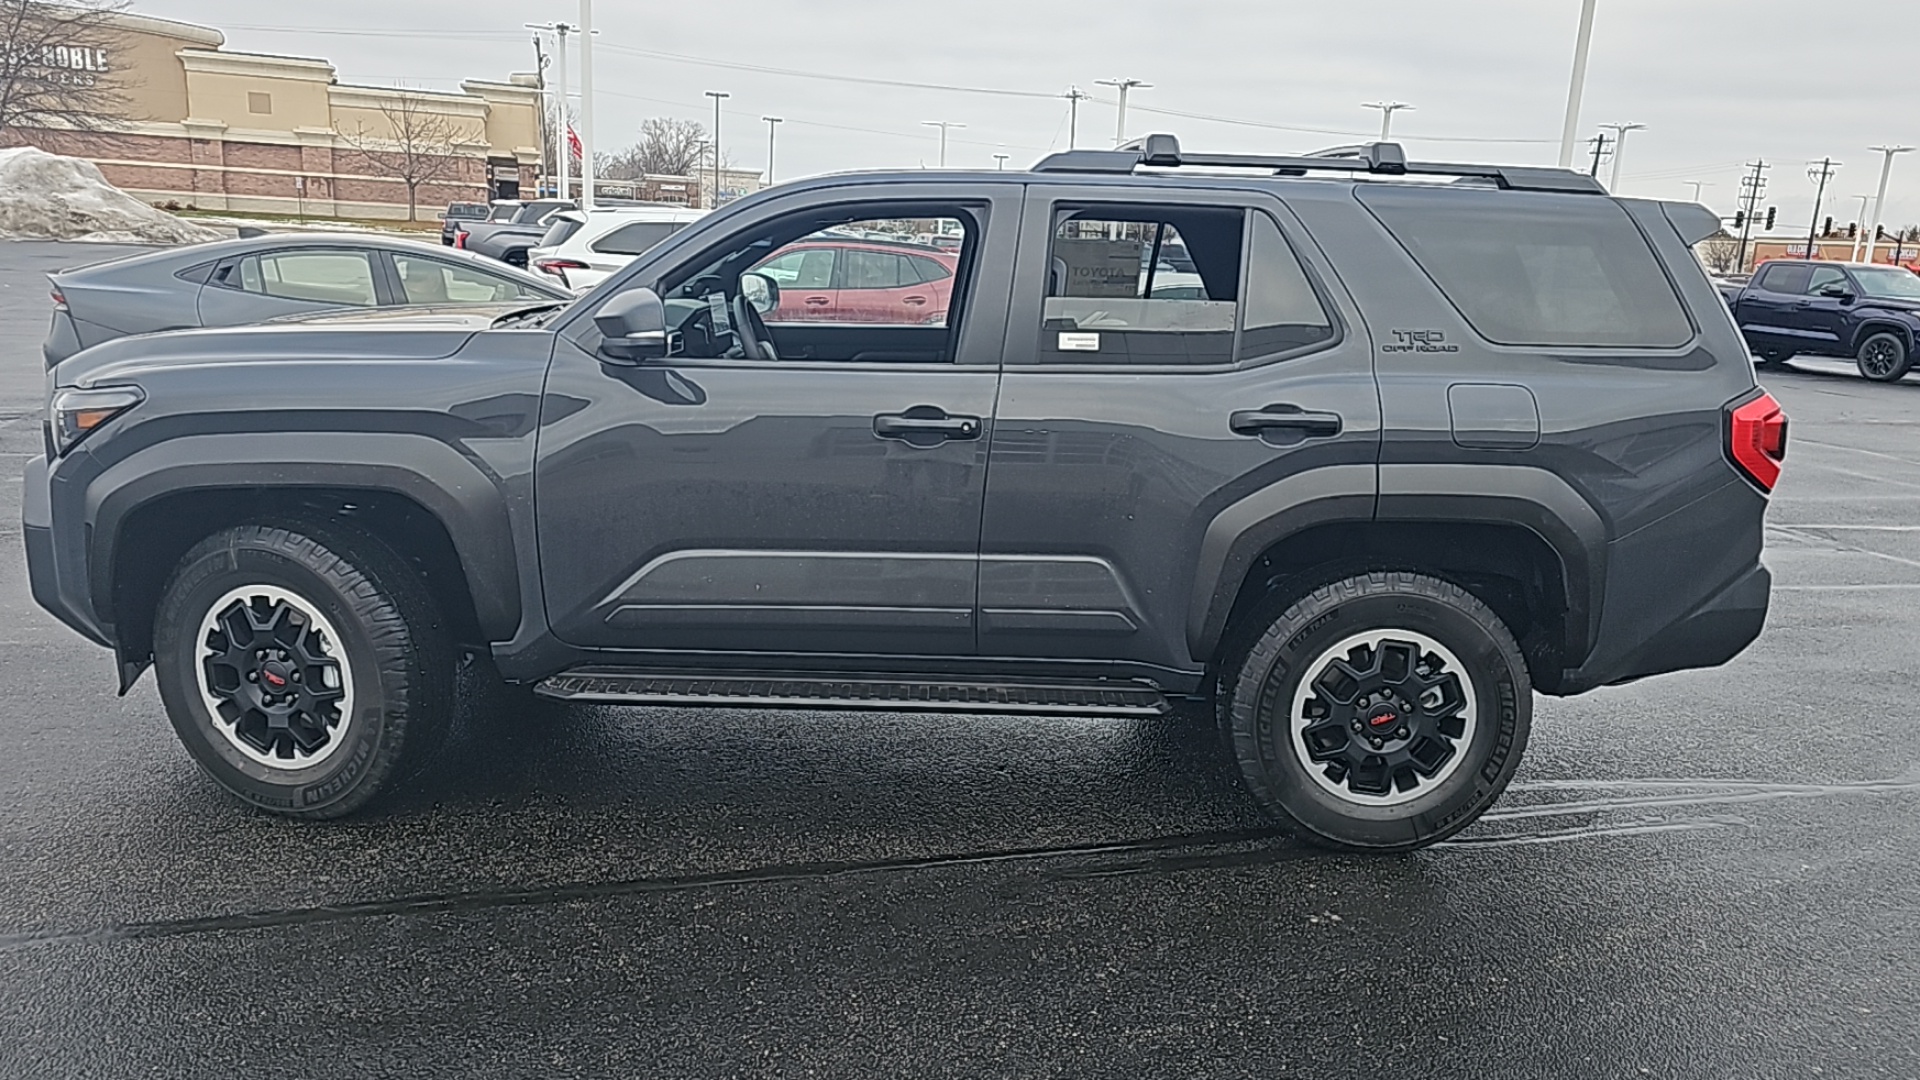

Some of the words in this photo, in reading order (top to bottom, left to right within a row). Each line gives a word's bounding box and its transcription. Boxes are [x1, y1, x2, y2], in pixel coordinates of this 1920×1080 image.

[42, 45, 109, 71] NOBLE
[1072, 266, 1124, 278] TOYOTA
[1391, 328, 1445, 346] TRD
[1415, 345, 1459, 353] ROAD
[1260, 662, 1288, 760] MICHELIN
[1484, 682, 1515, 779] MICHELIN
[305, 738, 370, 803] MICHELIN
